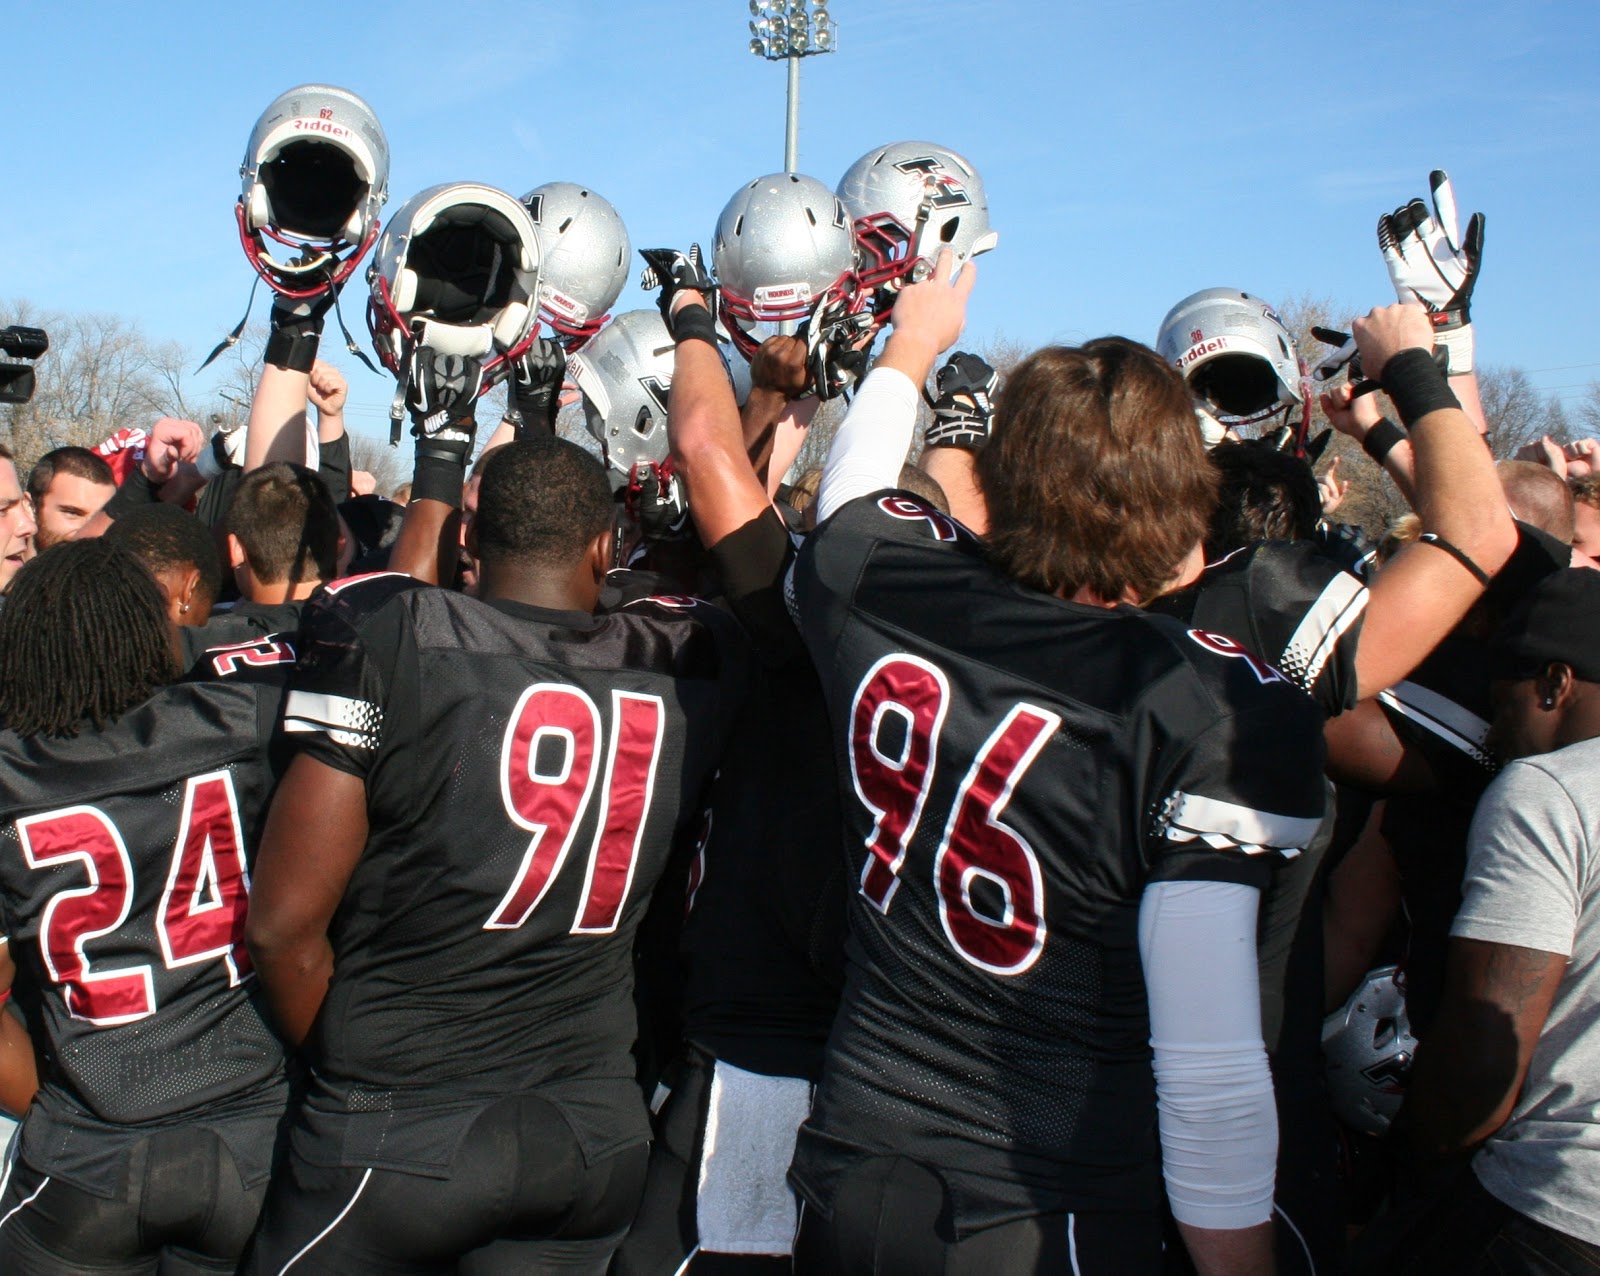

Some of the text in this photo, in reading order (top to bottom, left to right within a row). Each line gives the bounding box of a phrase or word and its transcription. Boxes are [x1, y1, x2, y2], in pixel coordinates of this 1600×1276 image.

[319, 108, 334, 120] 62
[767, 288, 795, 298] HOUNDS
[423, 409, 450, 434] NIKE
[877, 496, 966, 542] 9
[1186, 628, 1288, 684] 9
[483, 683, 666, 935] 91
[847, 652, 1063, 976] 96
[16, 769, 254, 1026] 24
